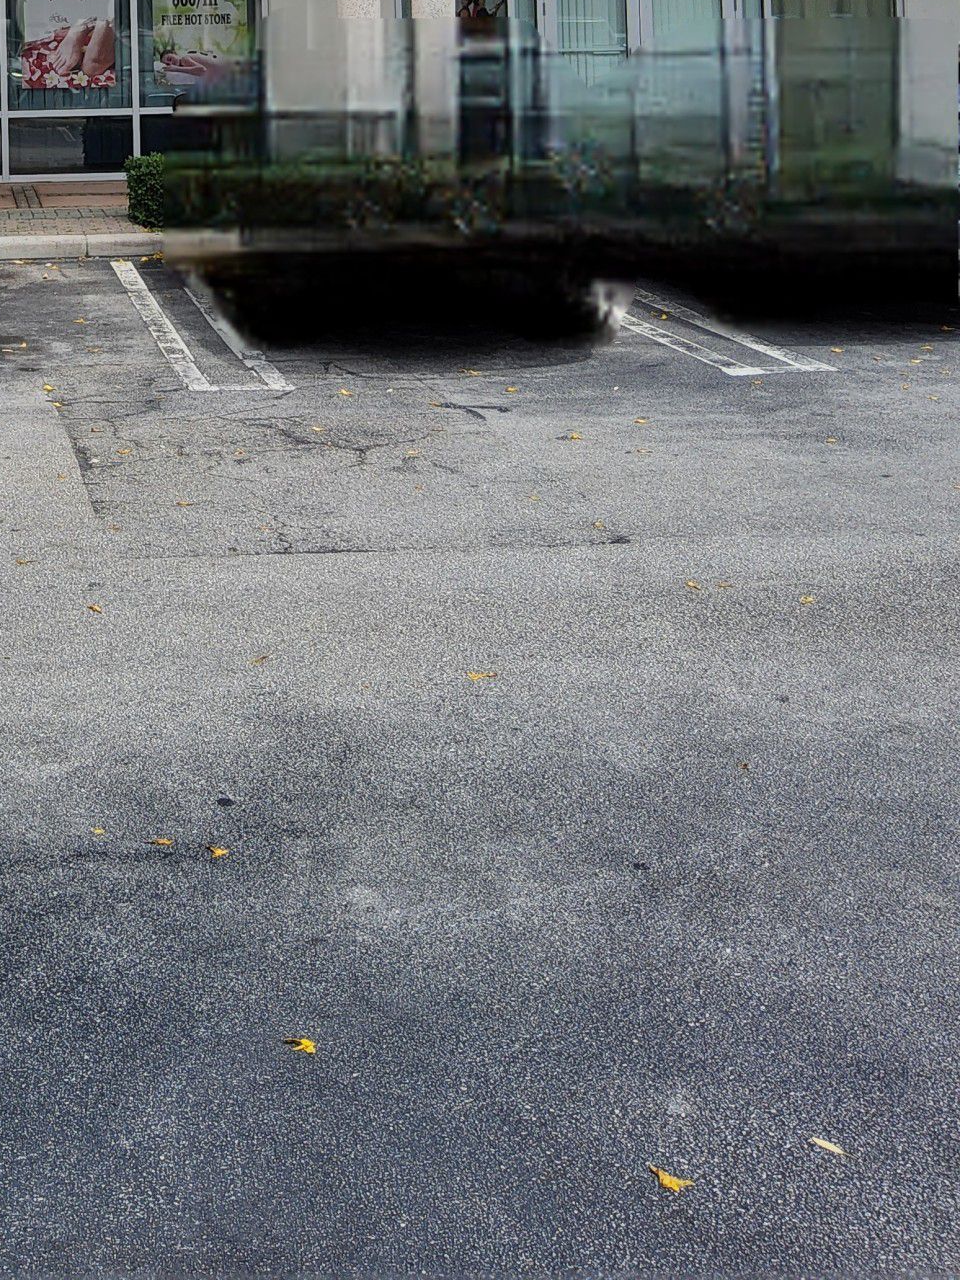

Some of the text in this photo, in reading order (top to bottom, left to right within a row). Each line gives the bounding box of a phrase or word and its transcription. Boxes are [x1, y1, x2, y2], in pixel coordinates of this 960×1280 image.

[161, 13, 232, 26] FREE HOT STONE
